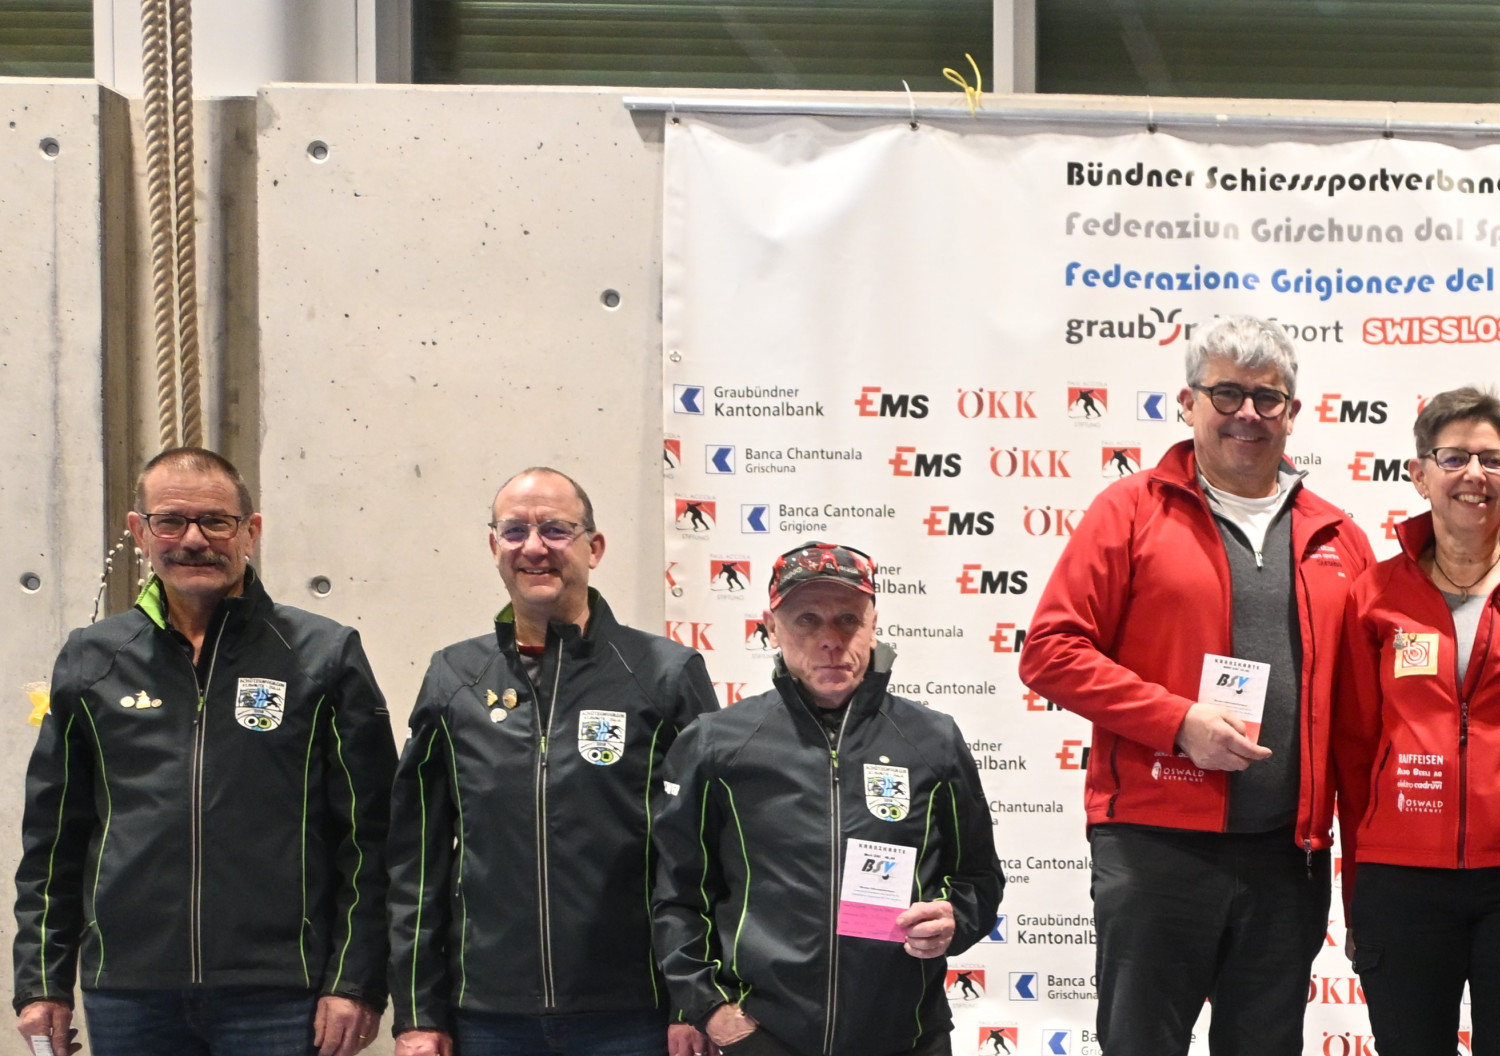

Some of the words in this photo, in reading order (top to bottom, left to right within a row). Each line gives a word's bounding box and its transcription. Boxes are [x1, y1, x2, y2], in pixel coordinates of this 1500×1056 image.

[1066, 161, 1194, 188] Bündner
[1065, 212, 1239, 241] Federaziun
[1251, 218, 1403, 244] Grischuna
[1414, 217, 1463, 242] dal
[1065, 262, 1261, 292] Federazione
[1271, 268, 1435, 302] Grigionese
[1445, 267, 1494, 292] del
[1284, 319, 1344, 343] port
[714, 386, 799, 399] Graubündner
[714, 402, 824, 417] Kantonalbank
[854, 386, 930, 419] EMS
[957, 387, 1038, 419] ÖKK
[1315, 393, 1388, 424] EMS
[745, 448, 783, 460] Banca
[787, 447, 862, 461] Chantunala
[745, 463, 796, 474] Grischuna
[888, 446, 962, 477] EMS
[990, 447, 1071, 478] ÖKK
[779, 504, 819, 518] Banca
[823, 504, 896, 518] Cantonale
[779, 521, 827, 534] Grigione
[923, 506, 995, 536] EMS
[1023, 505, 1084, 536] ÖK
[956, 564, 1028, 595] EMS
[666, 621, 714, 651] KK
[888, 625, 964, 638] Chantunala
[888, 683, 921, 694] anca
[926, 681, 996, 695] Cantonale
[1216, 673, 1250, 689] BSV
[1398, 754, 1444, 765] RAIFFEISEN
[1164, 768, 1204, 777] OSWALD
[990, 800, 1064, 813] Chantunala
[1406, 799, 1443, 808] OSWALD
[862, 858, 896, 874] BSV
[1027, 857, 1093, 870] Cantonale
[1017, 914, 1096, 926] Graubündne
[1018, 931, 1097, 945] Kantonalb
[1047, 974, 1085, 987] Banca
[1048, 989, 1098, 1000] Grischuna
